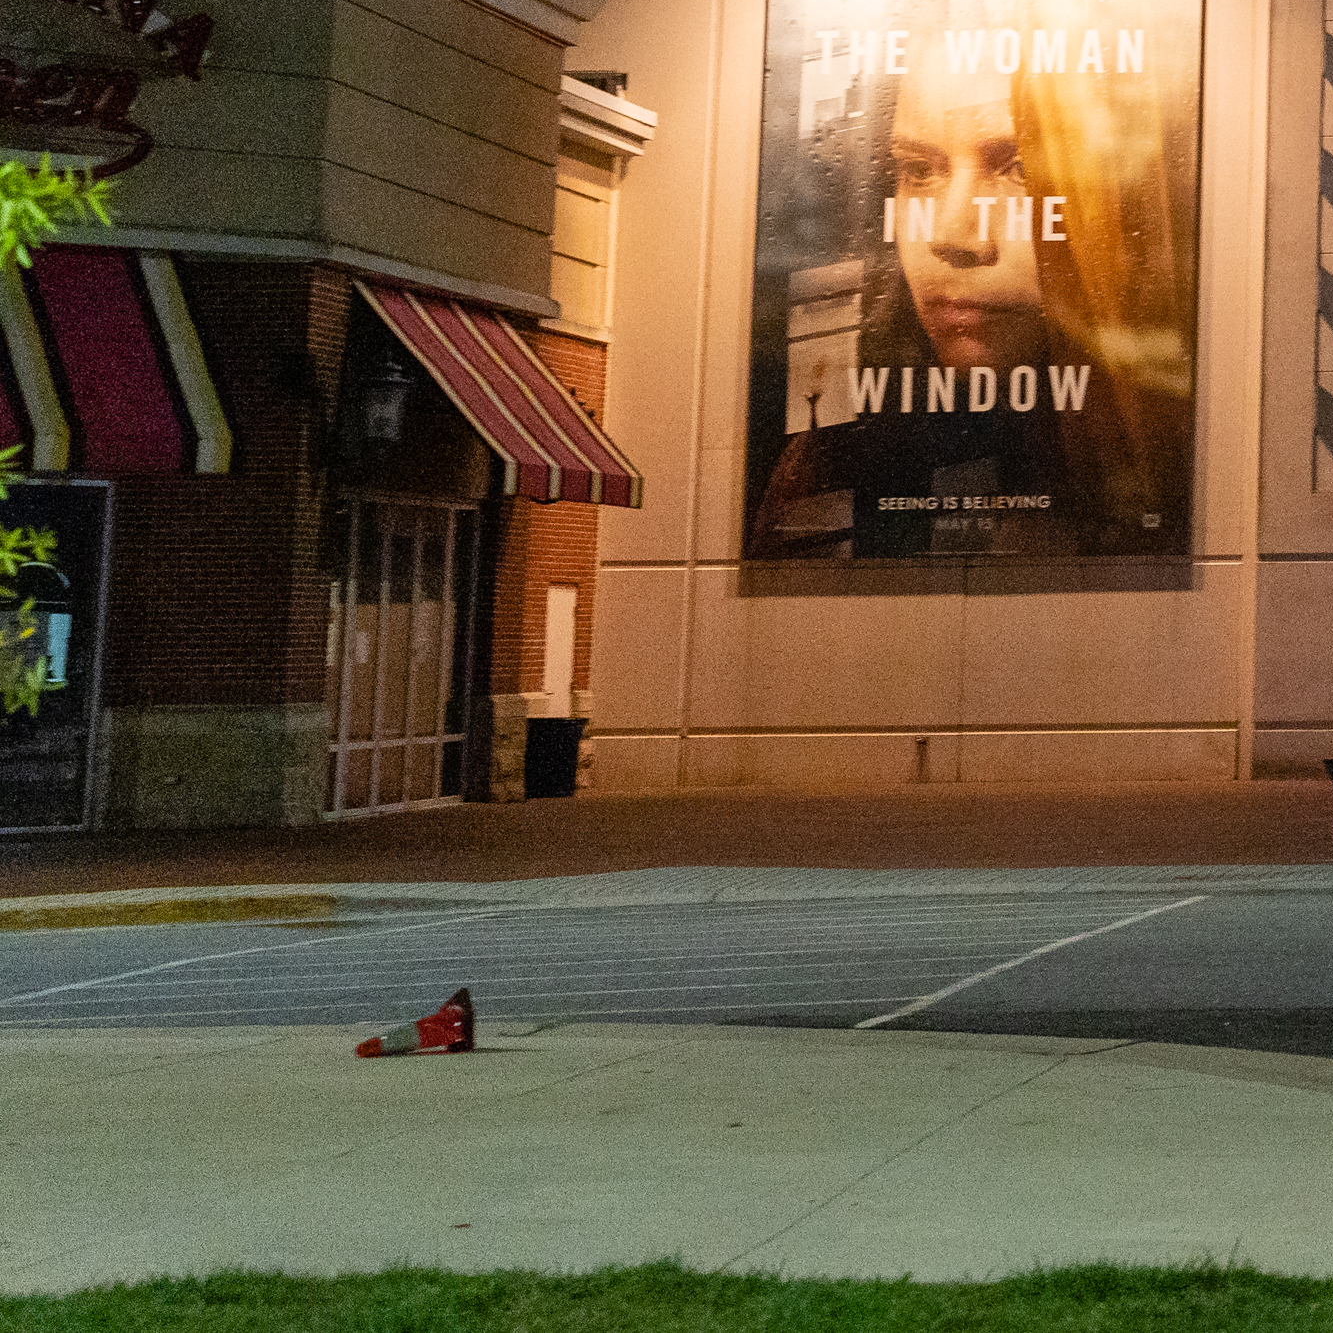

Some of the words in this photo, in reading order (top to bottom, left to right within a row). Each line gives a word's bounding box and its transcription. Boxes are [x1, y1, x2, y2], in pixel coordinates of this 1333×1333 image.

[816, 30, 909, 74] THE
[945, 29, 1144, 74] WOMAN
[883, 197, 936, 243] IN
[973, 196, 1067, 242] THE
[849, 365, 1091, 413] WINDOW
[878, 497, 938, 511] SEEING
[943, 497, 958, 510] IS
[962, 495, 1051, 509] BELIEVING
